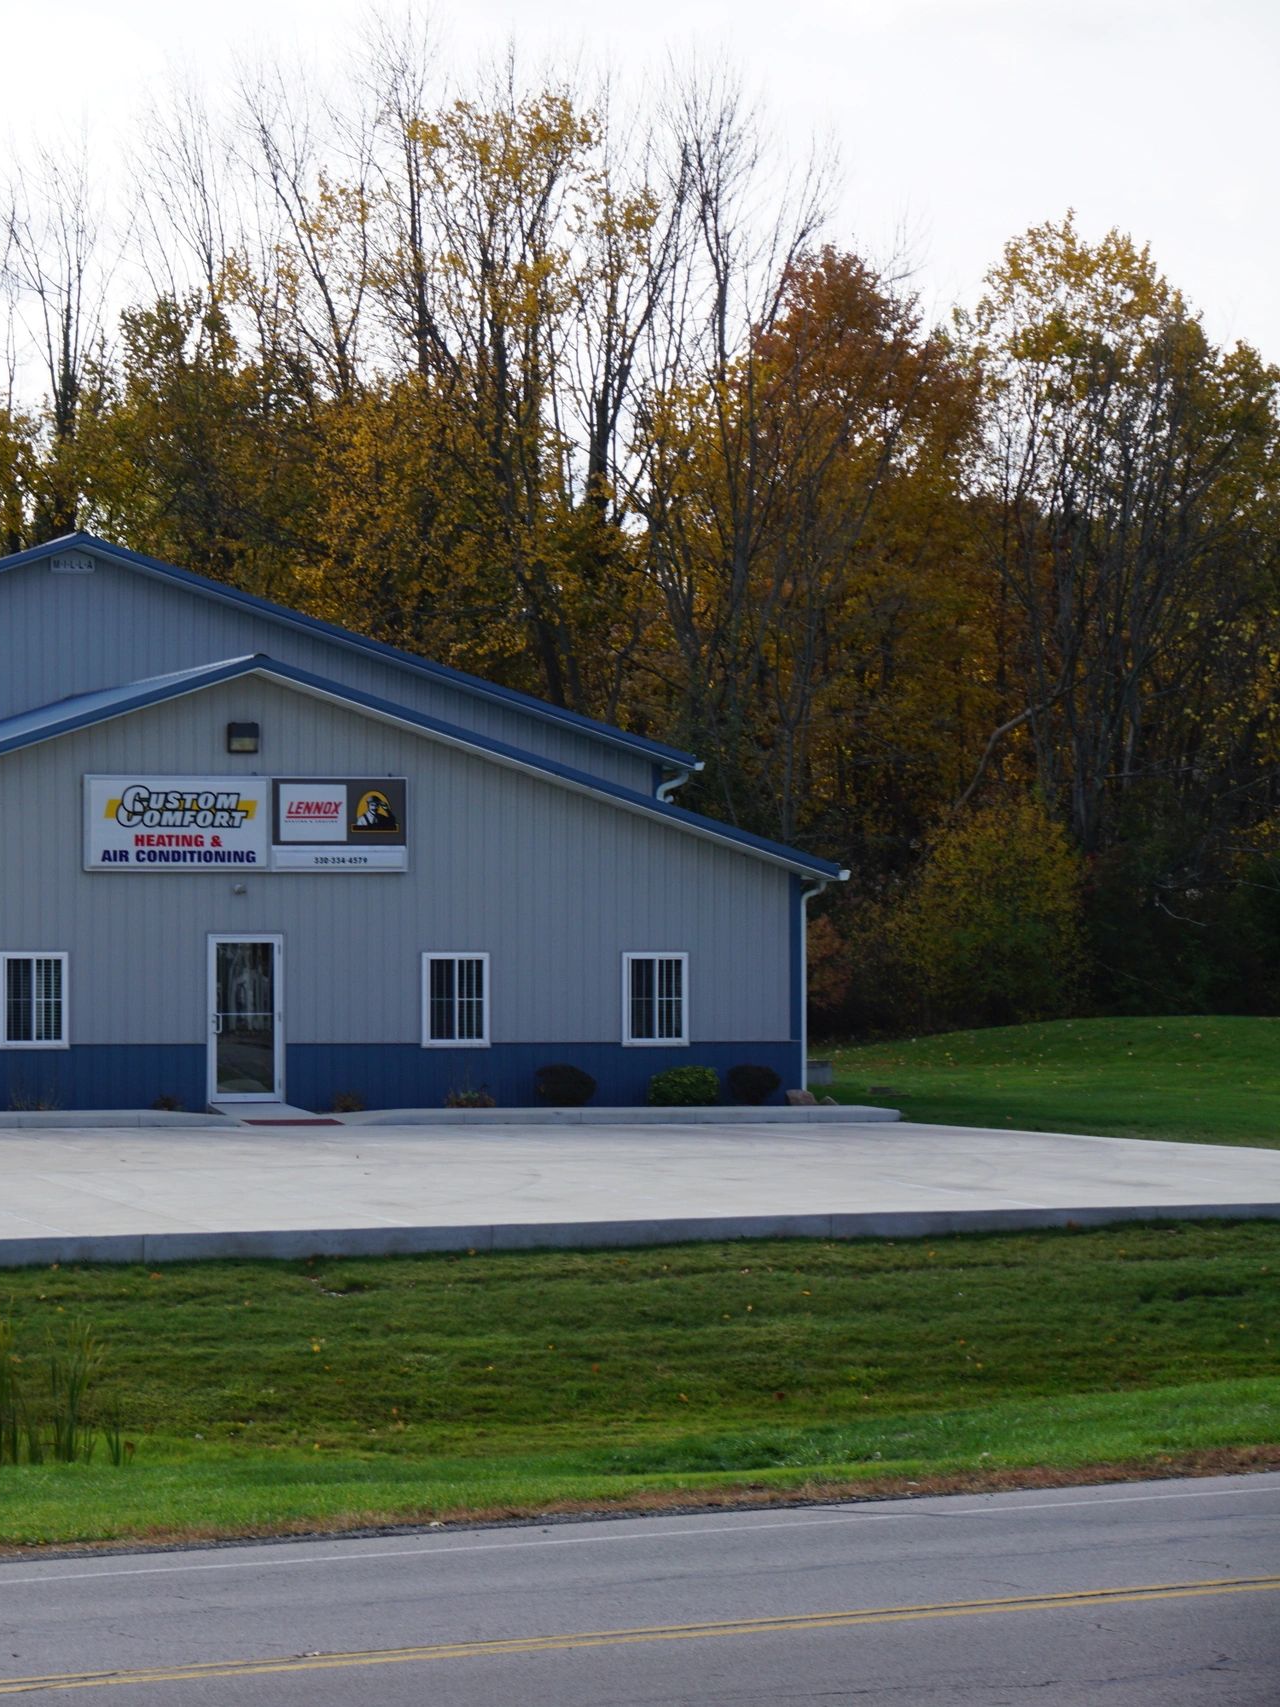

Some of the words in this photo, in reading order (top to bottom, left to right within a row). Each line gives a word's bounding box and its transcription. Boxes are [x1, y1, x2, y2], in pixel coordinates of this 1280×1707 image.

[122, 785, 241, 813] CUSTOM
[116, 800, 249, 828] COMFORT
[287, 801, 343, 815] LENNOX
[134, 834, 205, 847] HEATING
[210, 834, 223, 847] &
[101, 849, 130, 863] AIR
[135, 849, 257, 863] CONDITIONING
